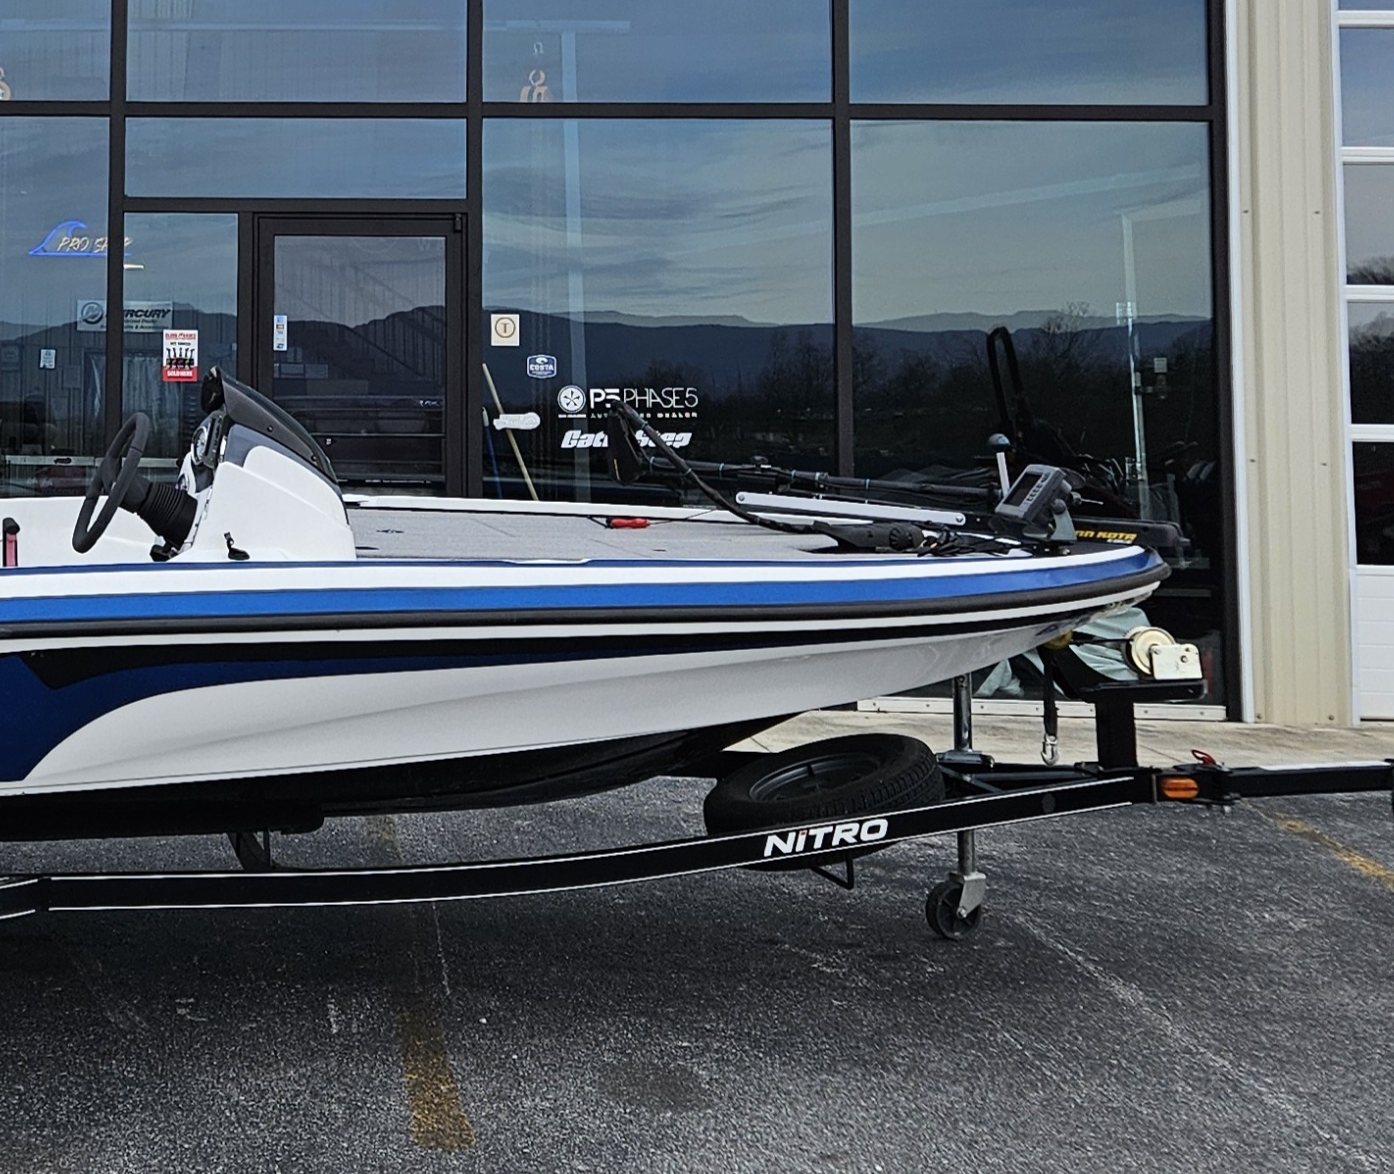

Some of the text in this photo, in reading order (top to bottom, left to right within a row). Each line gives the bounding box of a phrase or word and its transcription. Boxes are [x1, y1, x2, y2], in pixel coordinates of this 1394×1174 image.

[57, 236, 133, 254] PRO SHP
[105, 309, 171, 319] RCURY
[529, 364, 554, 372] COSTA
[623, 387, 699, 409] PHASE5
[1096, 531, 1138, 541] KOTA
